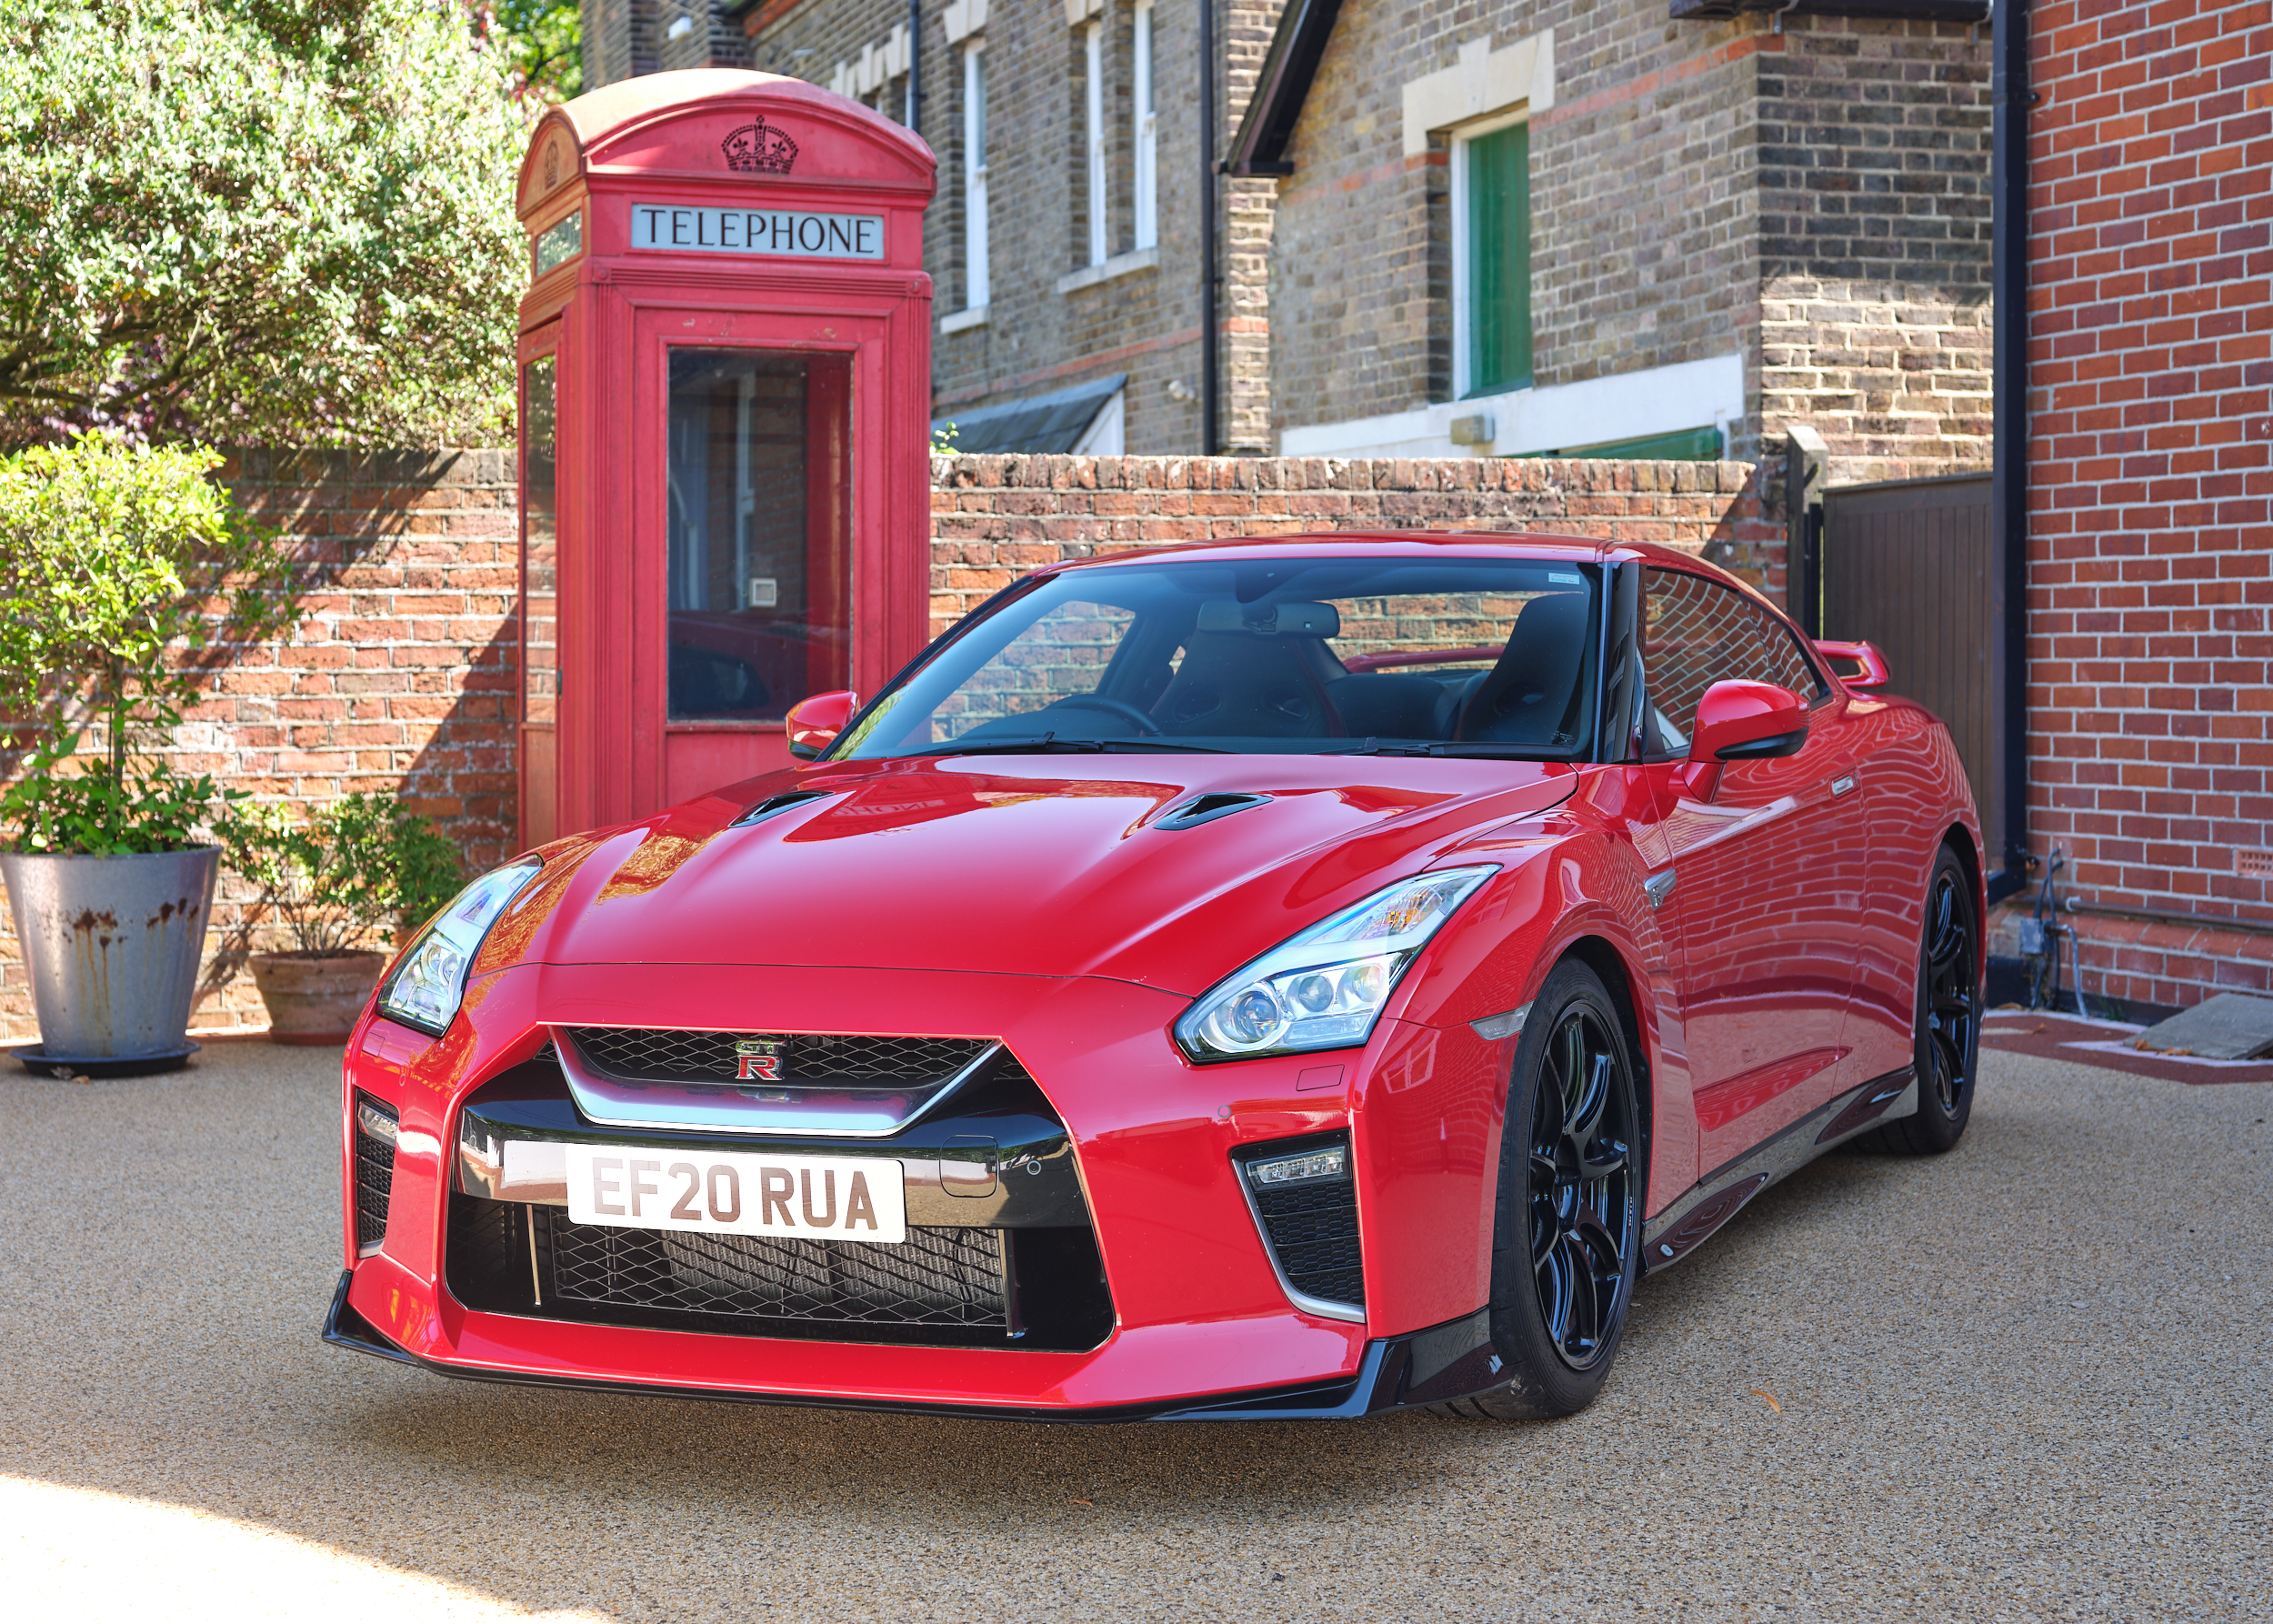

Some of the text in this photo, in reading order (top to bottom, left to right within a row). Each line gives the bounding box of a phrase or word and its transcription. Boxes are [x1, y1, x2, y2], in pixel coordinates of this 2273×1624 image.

[639, 208, 876, 254] TELEPHONE
[736, 1039, 786, 1054] GT
[735, 1055, 784, 1081] R
[592, 1157, 878, 1231] EF20 RUA
